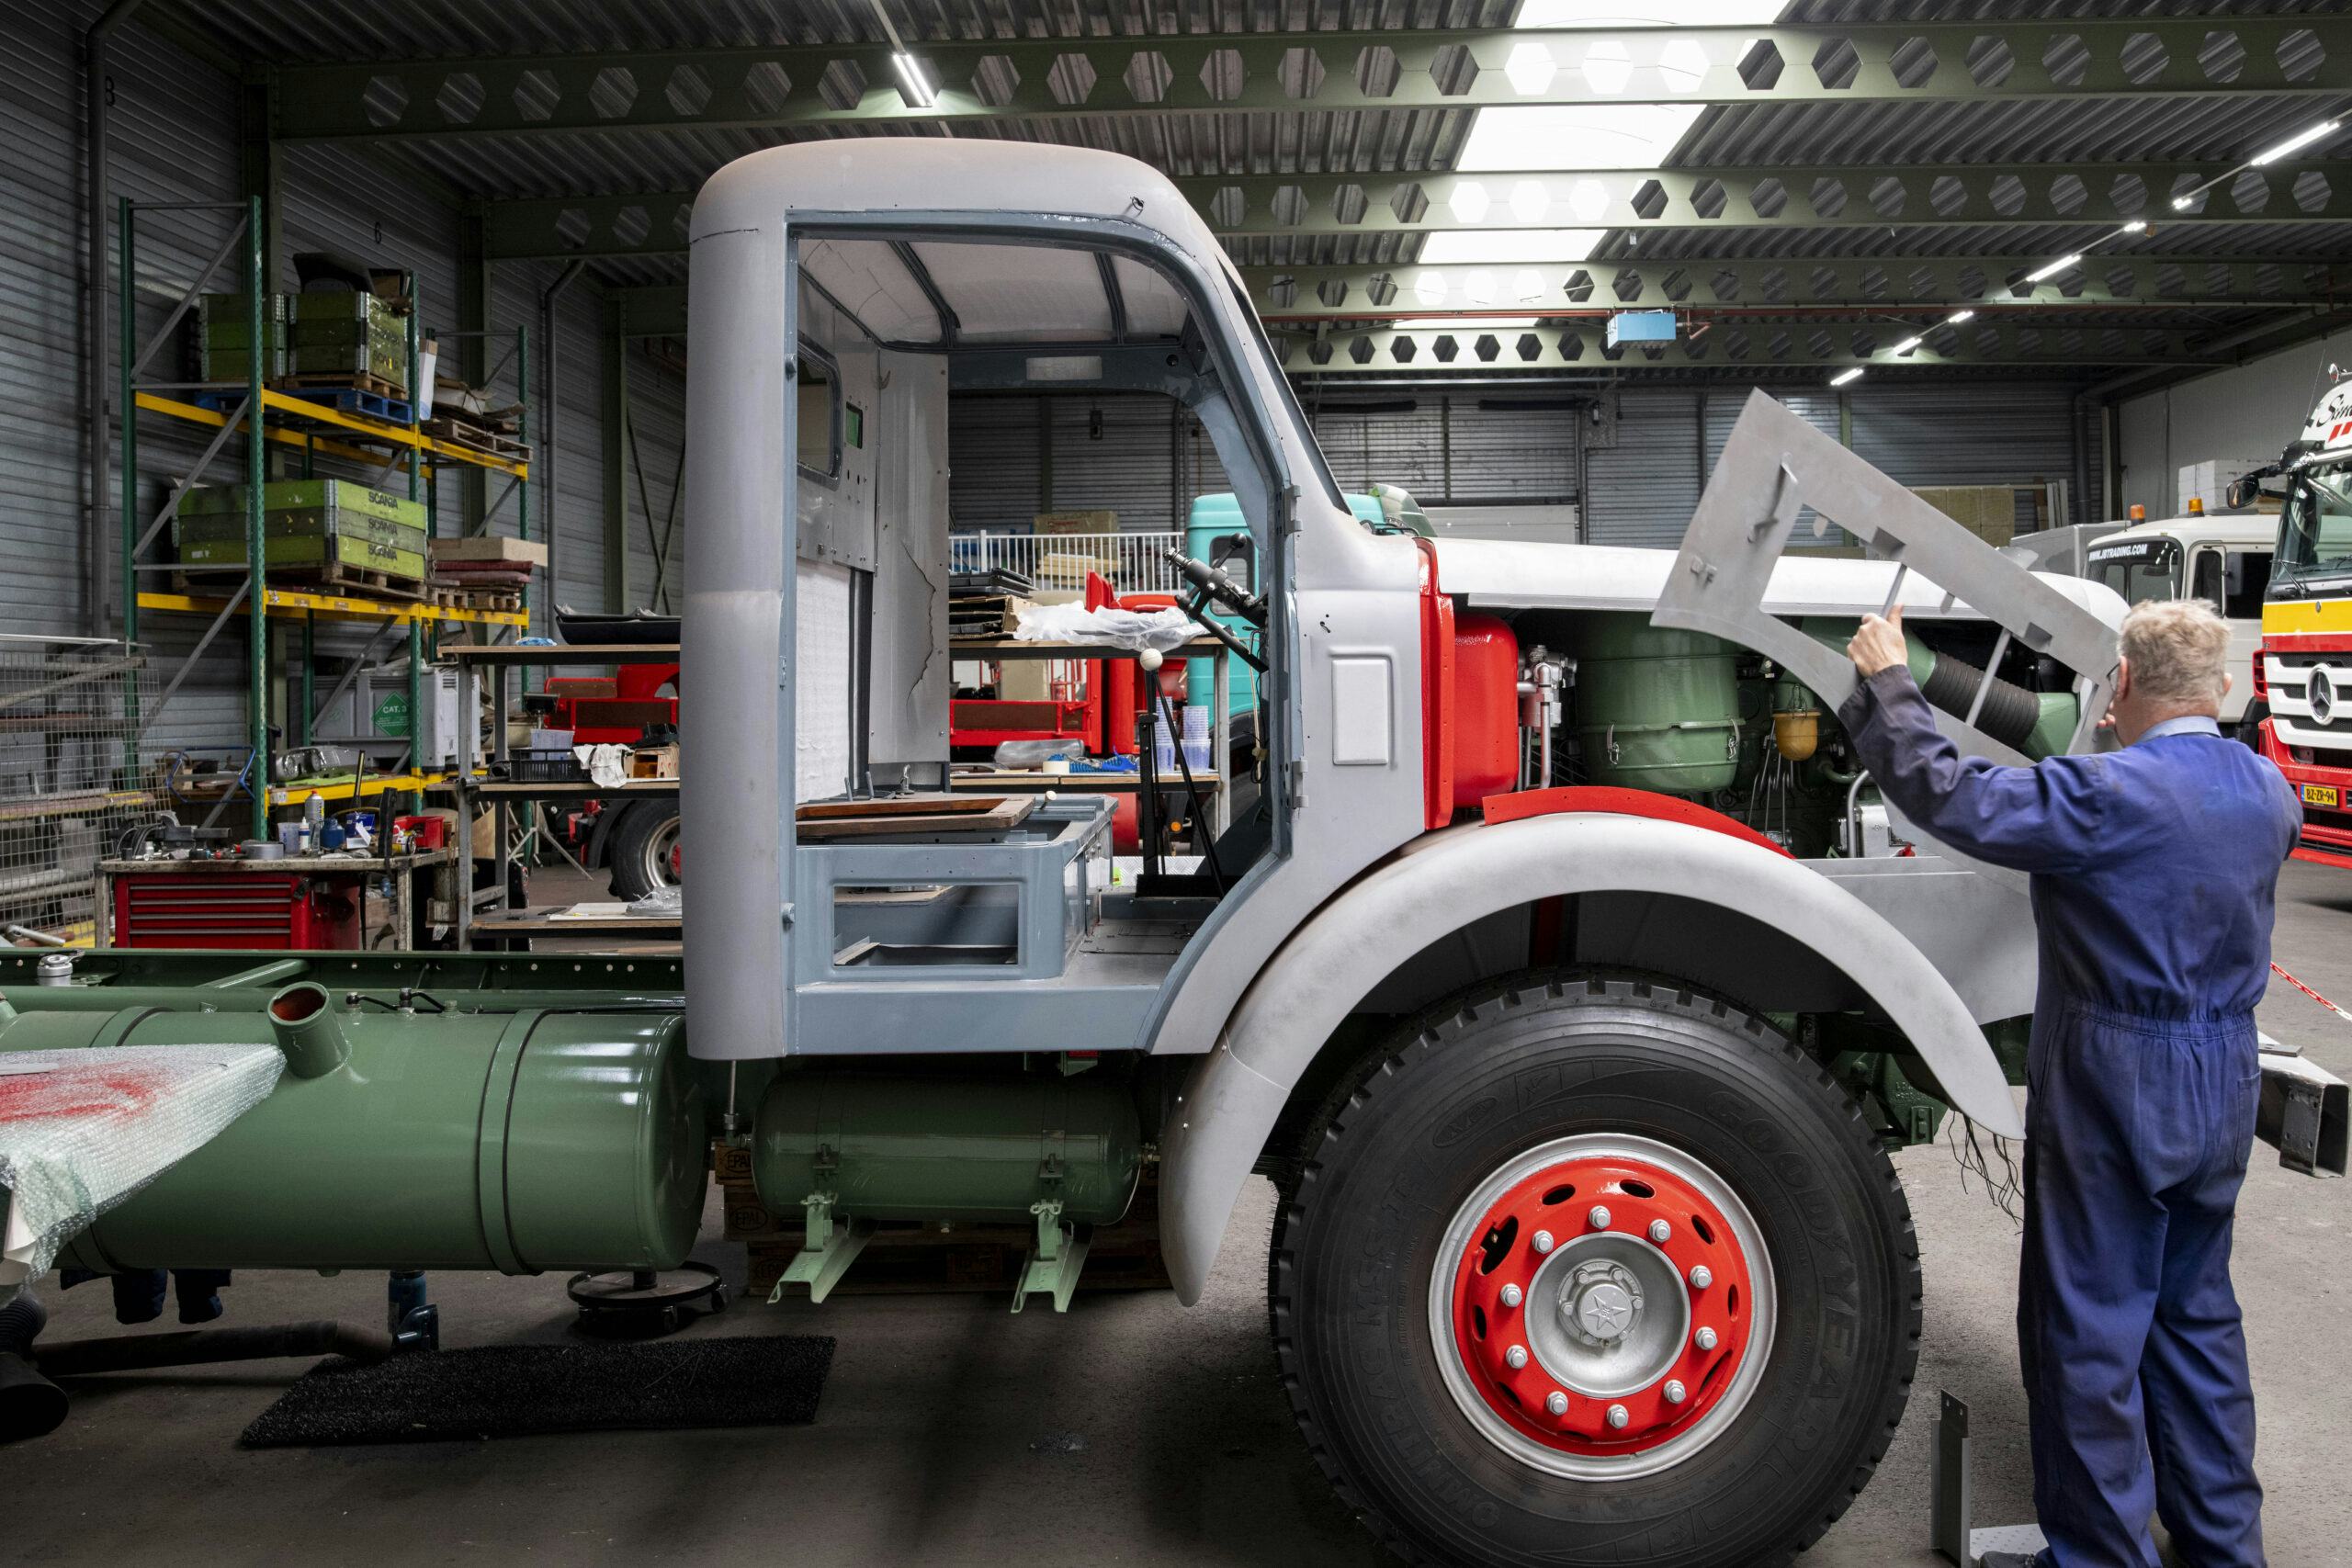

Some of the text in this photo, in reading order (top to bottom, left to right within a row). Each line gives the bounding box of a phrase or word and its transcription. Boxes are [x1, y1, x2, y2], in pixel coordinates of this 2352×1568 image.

[374, 220, 382, 244] 6
[368, 491, 398, 510] SCANIA
[368, 518, 398, 535] SCANIA
[368, 544, 398, 560] SCANIA
[382, 705, 401, 714] CAT.
[2306, 789, 2335, 803] BZ-ZR-94
[735, 1212, 761, 1226] EPAL
[1702, 1084, 1854, 1459] GOODYEAR
[1360, 1348, 1501, 1529] OMNITRAC
